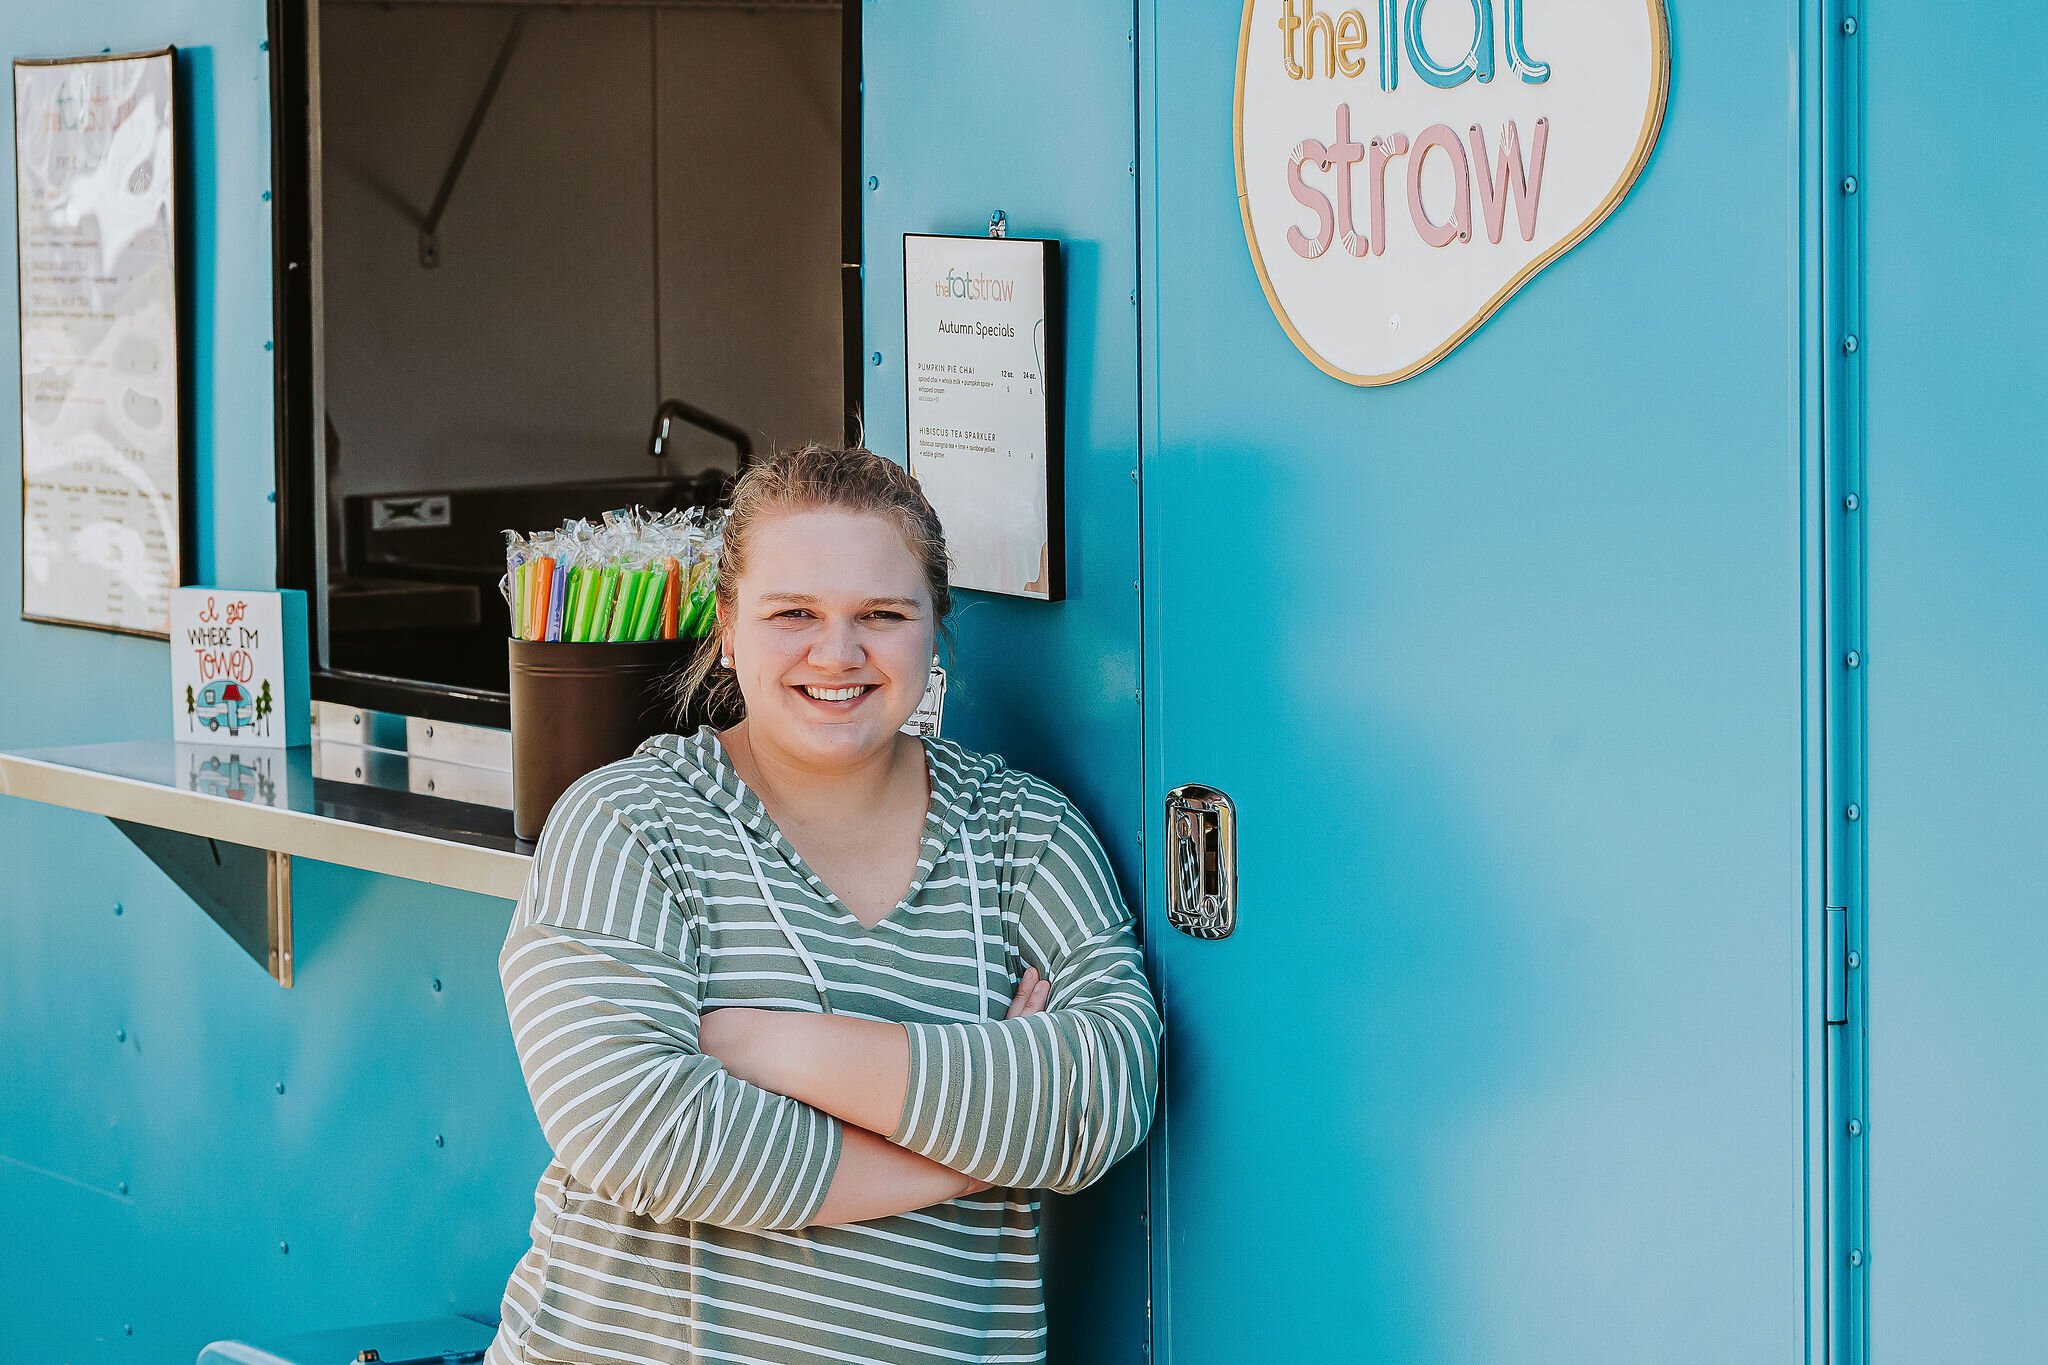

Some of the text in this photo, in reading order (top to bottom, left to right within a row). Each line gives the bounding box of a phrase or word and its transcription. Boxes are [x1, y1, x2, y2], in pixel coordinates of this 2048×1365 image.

[1278, 0, 1367, 80] the
[1286, 102, 1550, 259] straw
[938, 319, 1015, 339] Autumn Specials
[917, 362, 975, 375] PUMPKIN PIE CHAI
[1001, 370, 1007, 378] 12
[1023, 371, 1029, 379] 24
[919, 427, 996, 441] HIBISCUS TEA SPARKLER
[226, 600, 248, 625] go
[187, 626, 233, 648] WHERE
